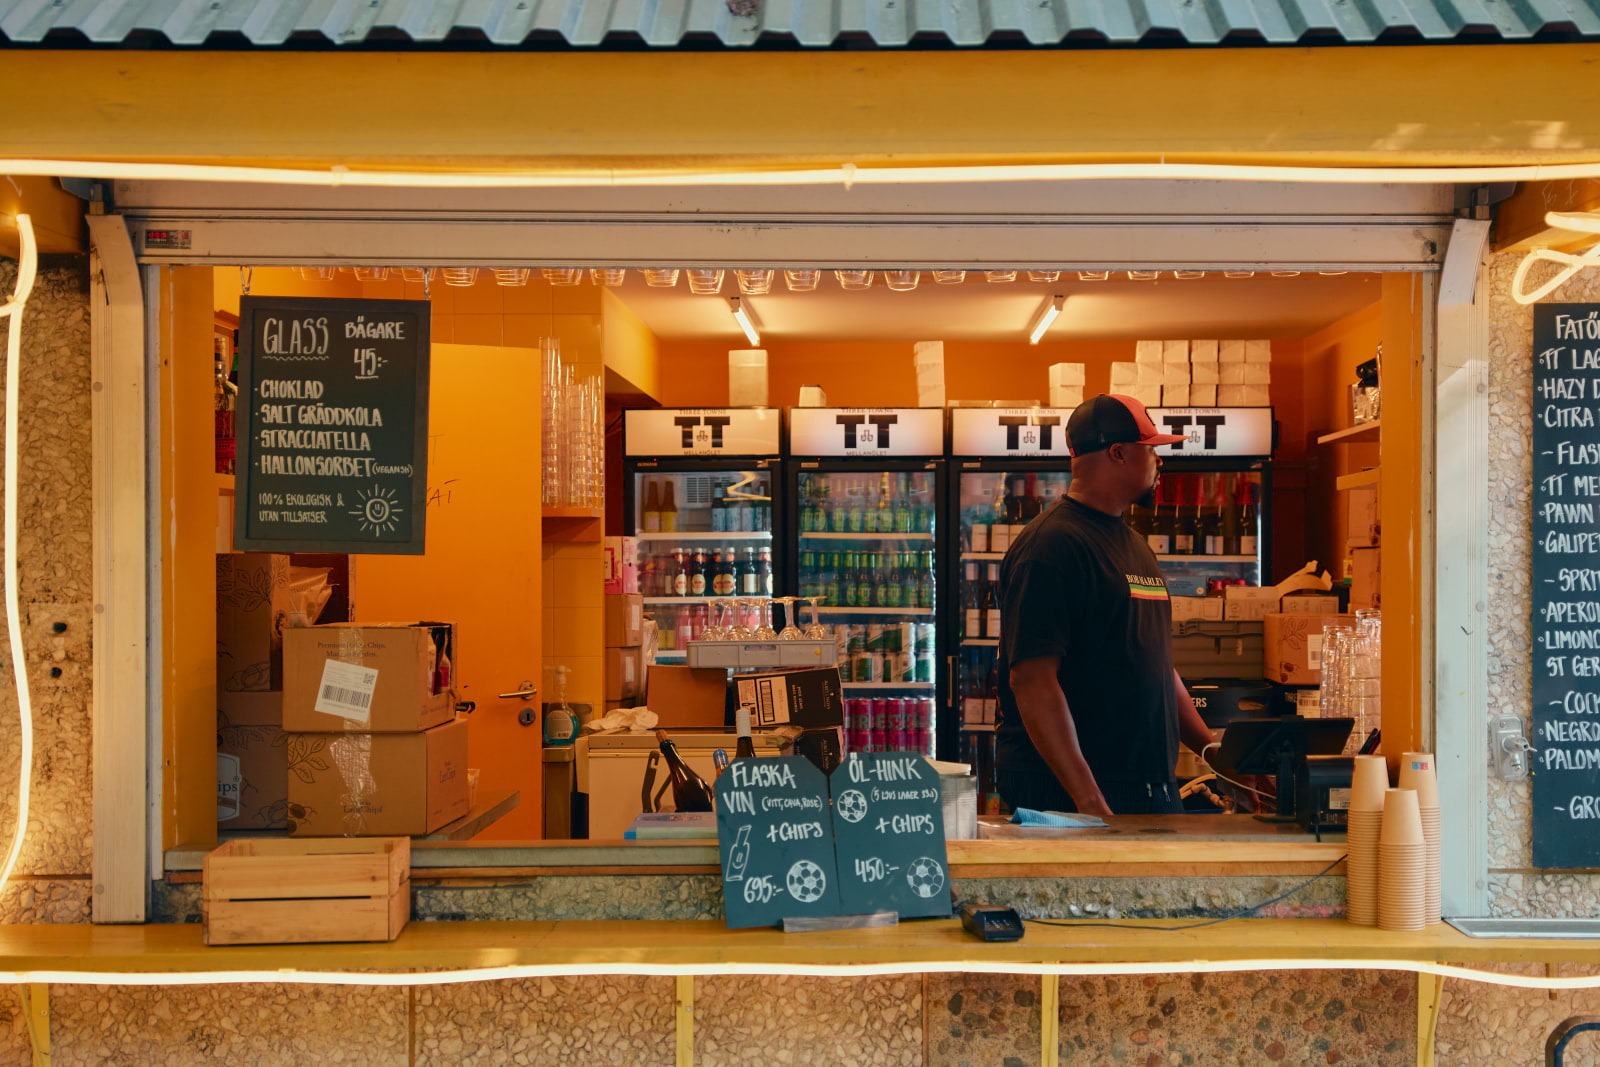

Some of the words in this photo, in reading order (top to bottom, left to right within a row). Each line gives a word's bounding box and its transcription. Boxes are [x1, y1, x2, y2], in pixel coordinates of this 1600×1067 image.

[263, 317, 329, 354] GLASS
[345, 315, 406, 340] BÄGARE
[1542, 346, 1567, 370] TT
[260, 379, 324, 399] CHOKLAD
[1543, 377, 1586, 400] HAZY
[260, 404, 297, 424] SALT
[298, 402, 383, 427] GRÄDDKOLA
[1544, 404, 1595, 428] CITRA
[260, 429, 371, 451] STRACCIATELLA
[1557, 441, 1600, 465] FLAS
[260, 455, 375, 478] HALLONSORBET
[1543, 472, 1568, 496] TT
[1574, 475, 1600, 497] ME
[259, 493, 284, 506] 100%
[286, 493, 332, 507] EKOLOGISK
[337, 493, 344, 507] &
[259, 510, 279, 522] UTAN
[280, 511, 328, 523] TILLSATSER
[1544, 502, 1594, 524] PAWN
[1546, 656, 1567, 677] ST
[1572, 655, 1600, 677] GER
[731, 761, 797, 789] FLASKA
[848, 752, 922, 783] ÖL-HINK
[722, 790, 756, 816] VIN
[854, 857, 900, 883] 450:-
[743, 874, 784, 904] 695:-
